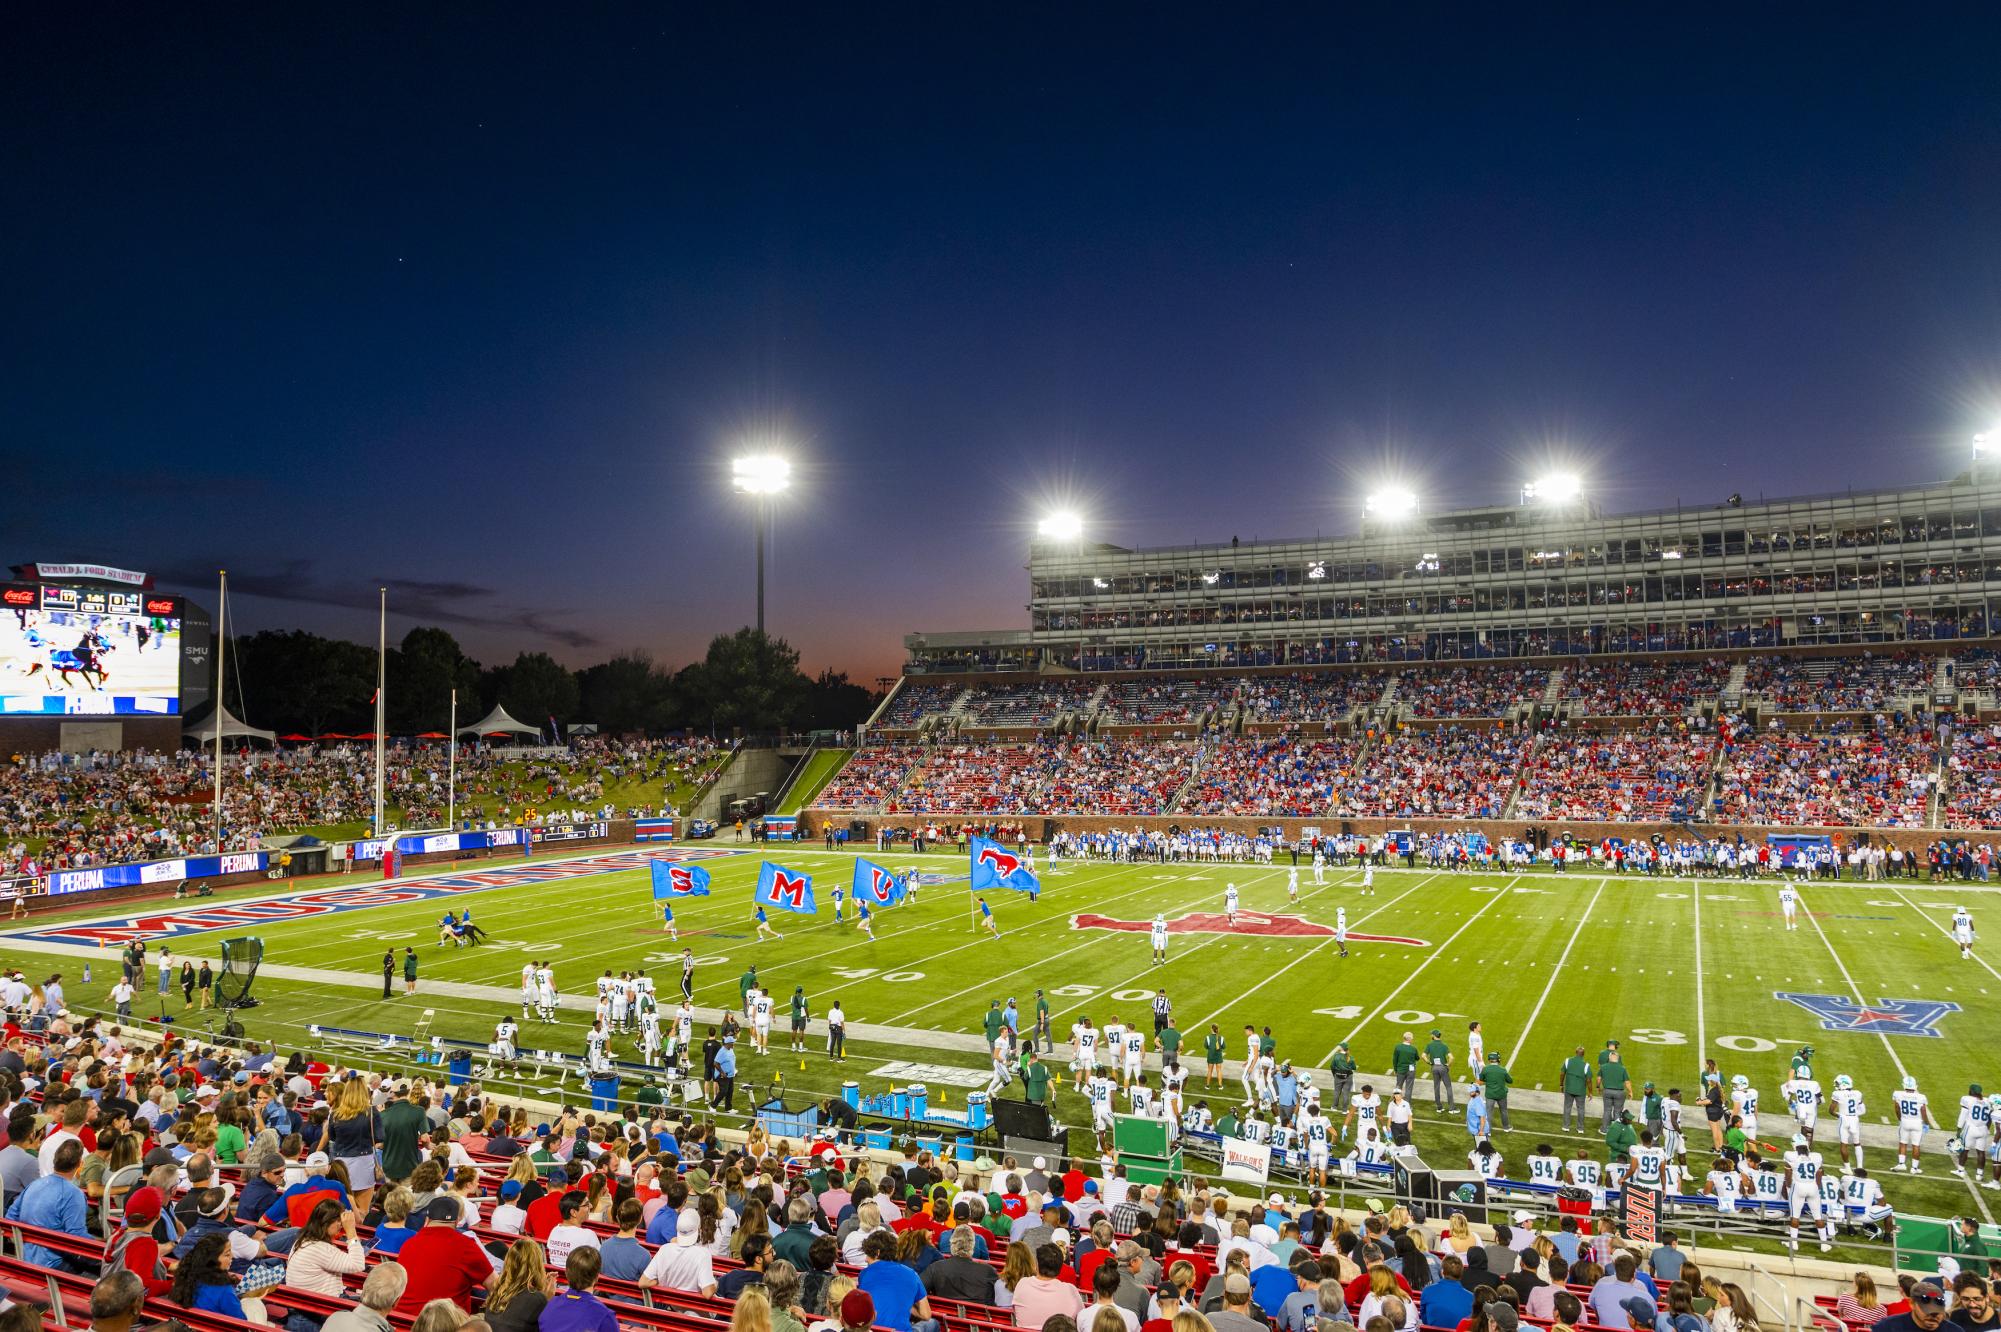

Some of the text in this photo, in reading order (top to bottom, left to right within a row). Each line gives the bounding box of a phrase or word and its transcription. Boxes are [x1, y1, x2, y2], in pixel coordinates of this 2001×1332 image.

[84, 566, 106, 577] FORD
[107, 570, 142, 582] STADIUM
[4, 590, 35, 601] Coca-Cola
[147, 600, 174, 611] Coca-Cola
[185, 646, 208, 655] SMU
[525, 808, 536, 820] 25
[220, 852, 259, 874] PERUNA
[60, 869, 104, 893] PERUNA
[669, 867, 695, 893] S
[871, 866, 894, 902] U
[768, 870, 806, 908] M
[1783, 894, 1793, 903] 55
[1957, 917, 1967, 927] 80
[615, 984, 624, 996] 74
[637, 982, 646, 994] 71
[1050, 984, 1157, 1002] 50
[757, 1002, 768, 1014] 67
[1311, 1005, 1435, 1025] 40
[500, 1024, 509, 1037] 5
[1108, 1031, 1120, 1044] 97
[1081, 1034, 1094, 1047] 57
[1128, 1039, 1140, 1052] 45
[1628, 1027, 1777, 1053] 30
[1796, 1088, 1813, 1105] 22
[1361, 1106, 1375, 1119] 36
[1743, 1099, 1756, 1115] 45
[1848, 1098, 1856, 1114] 2
[1901, 1099, 1918, 1116] 85
[1971, 1104, 1990, 1122] 86
[1246, 1123, 1258, 1141] 31
[1272, 1129, 1286, 1147] 28
[1309, 1124, 1325, 1141] 43
[1365, 1147, 1375, 1163] 0
[1481, 1155, 1491, 1174] 2
[1534, 1160, 1553, 1179] 94
[1641, 1155, 1659, 1175] 93
[1797, 1162, 1816, 1180] 49
[1577, 1165, 1597, 1184] 95
[1723, 1174, 1735, 1191] 3
[1757, 1174, 1777, 1194] 48
[1848, 1180, 1865, 1199] 41
